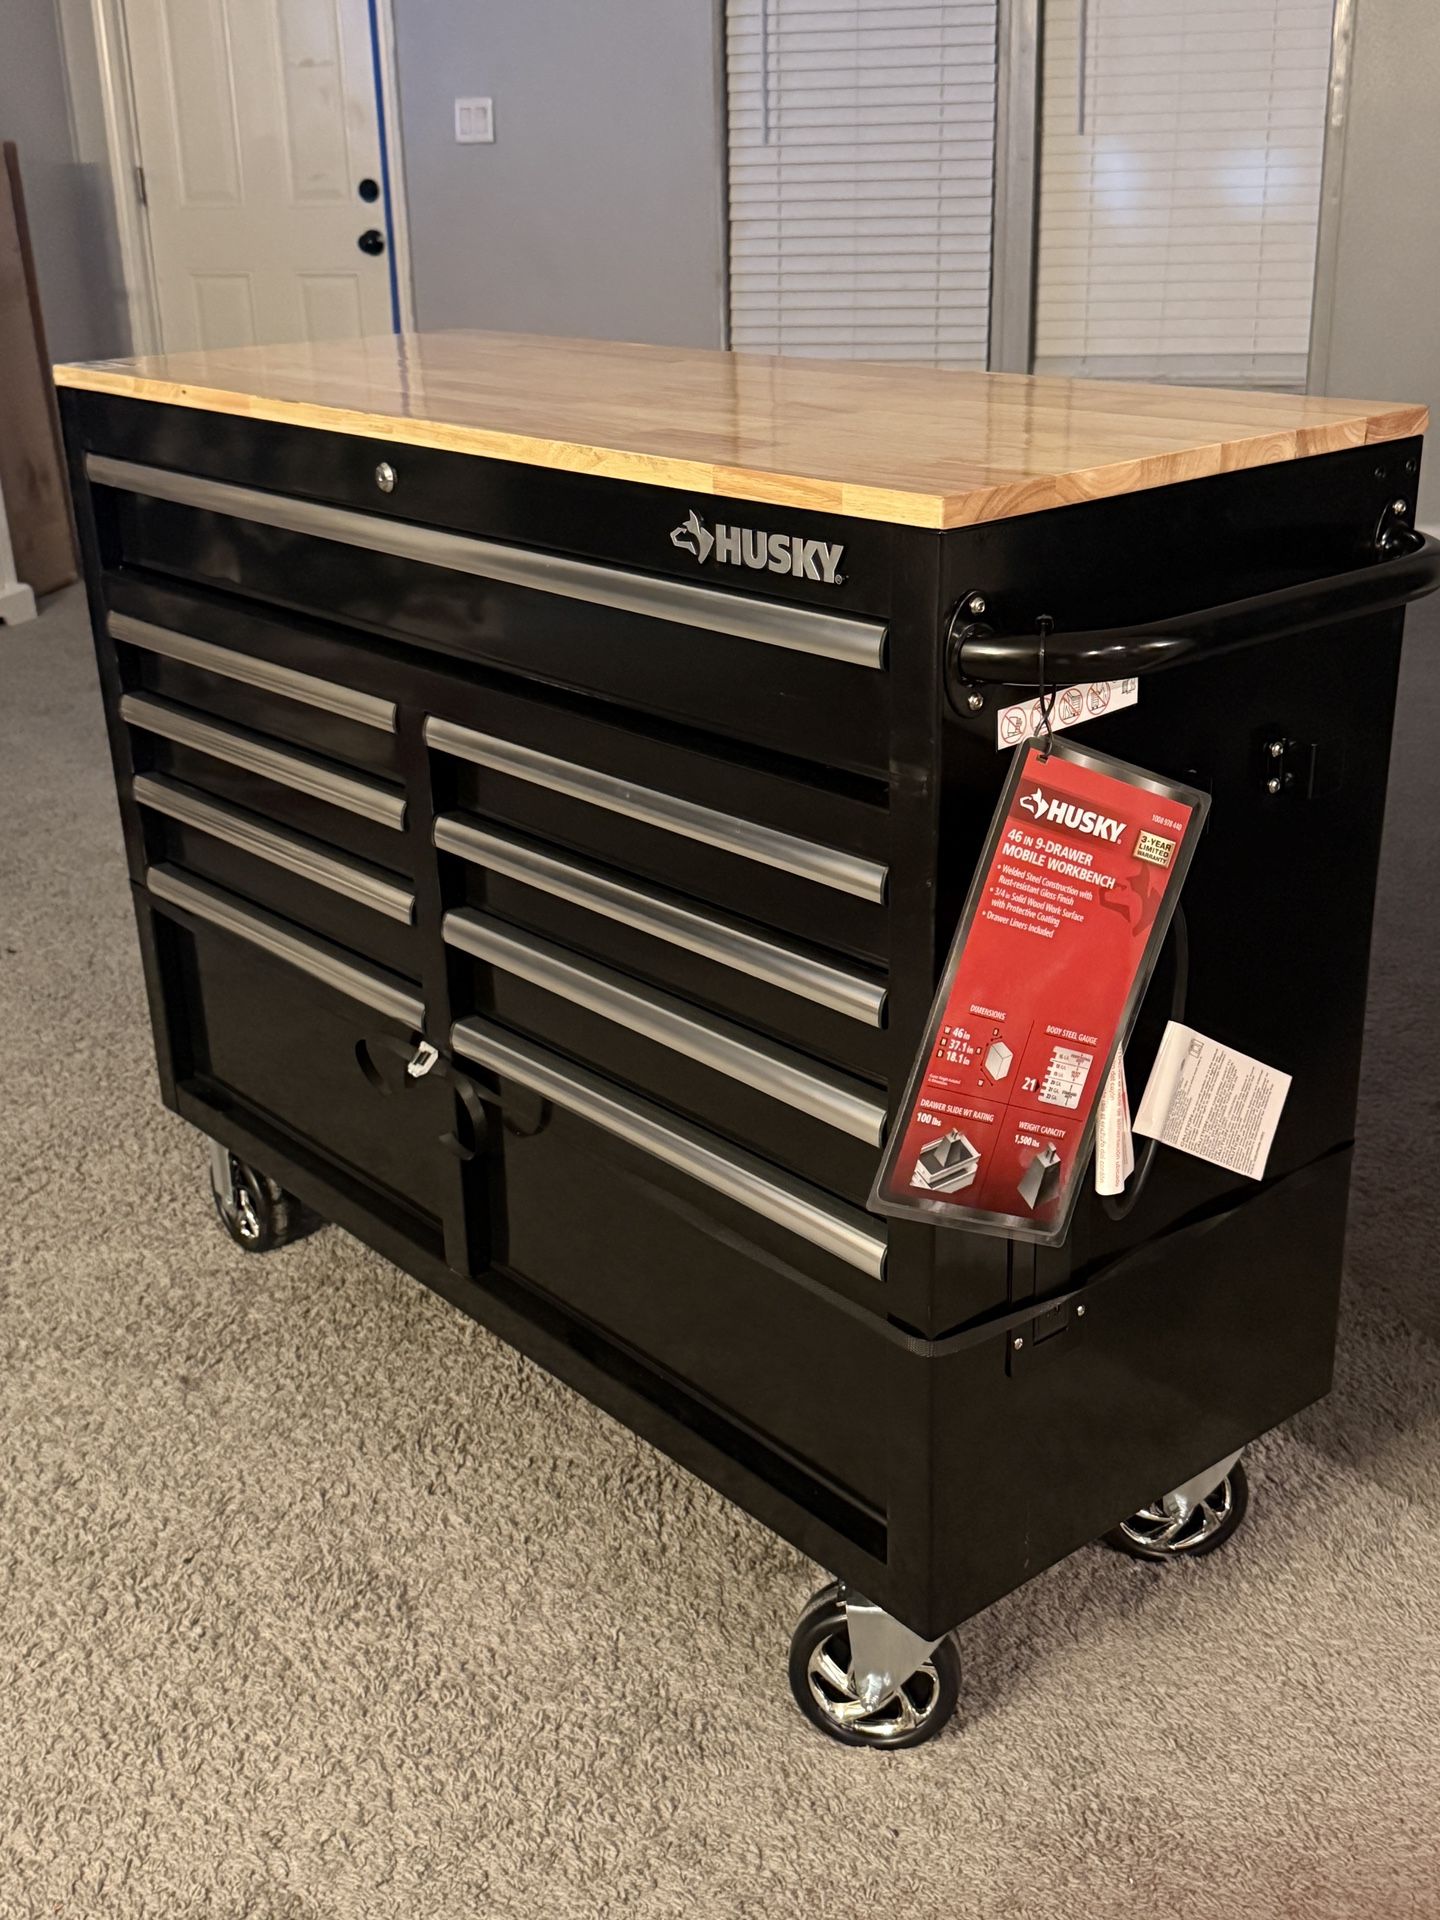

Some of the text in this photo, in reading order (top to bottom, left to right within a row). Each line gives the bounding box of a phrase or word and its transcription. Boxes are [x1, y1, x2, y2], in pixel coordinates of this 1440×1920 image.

[715, 523, 844, 583] HUSKY
[1047, 799, 1127, 842] HUSKY
[1007, 828, 1094, 866] 46 IN 9-DRAWER
[1139, 843, 1169, 858] LIMITED
[1141, 835, 1172, 851] 3-YEAR
[1002, 842, 1116, 890] MOBILE WORKBENCH
[1137, 850, 1168, 864] WARRANTY
[998, 875, 1075, 906] Rust-resistant Gloss Finish
[1002, 864, 1093, 901] Welded Steel Construction with
[991, 899, 1061, 928] with Protective Coating
[994, 888, 1006, 897] 3/4
[1011, 893, 1027, 904] Solid
[1027, 897, 1045, 910] Wood
[1045, 903, 1062, 915] Work
[1061, 908, 1085, 922] Surface
[986, 911, 1055, 938] Drawer Liners Included
[970, 1004, 1006, 1020] DIMENSIONS
[952, 1027, 964, 1038] 46
[963, 1031, 971, 1040] in
[1046, 1025, 1098, 1045] BODY STEEL GAUGE
[948, 1039, 968, 1053] 37.1
[966, 1045, 974, 1054] in
[946, 1051, 964, 1064] 18.1
[963, 1057, 971, 1066] in
[1021, 1076, 1037, 1092] 21
[917, 1112, 942, 1127] 100 lbs
[920, 1099, 995, 1123] DRAWER SLIDE WT RATING
[1018, 1121, 1066, 1138] WEIGHT CAPACITY
[1178, 1113, 1195, 1147] CAUTION
[1014, 1134, 1040, 1148] 1,500 lbs
